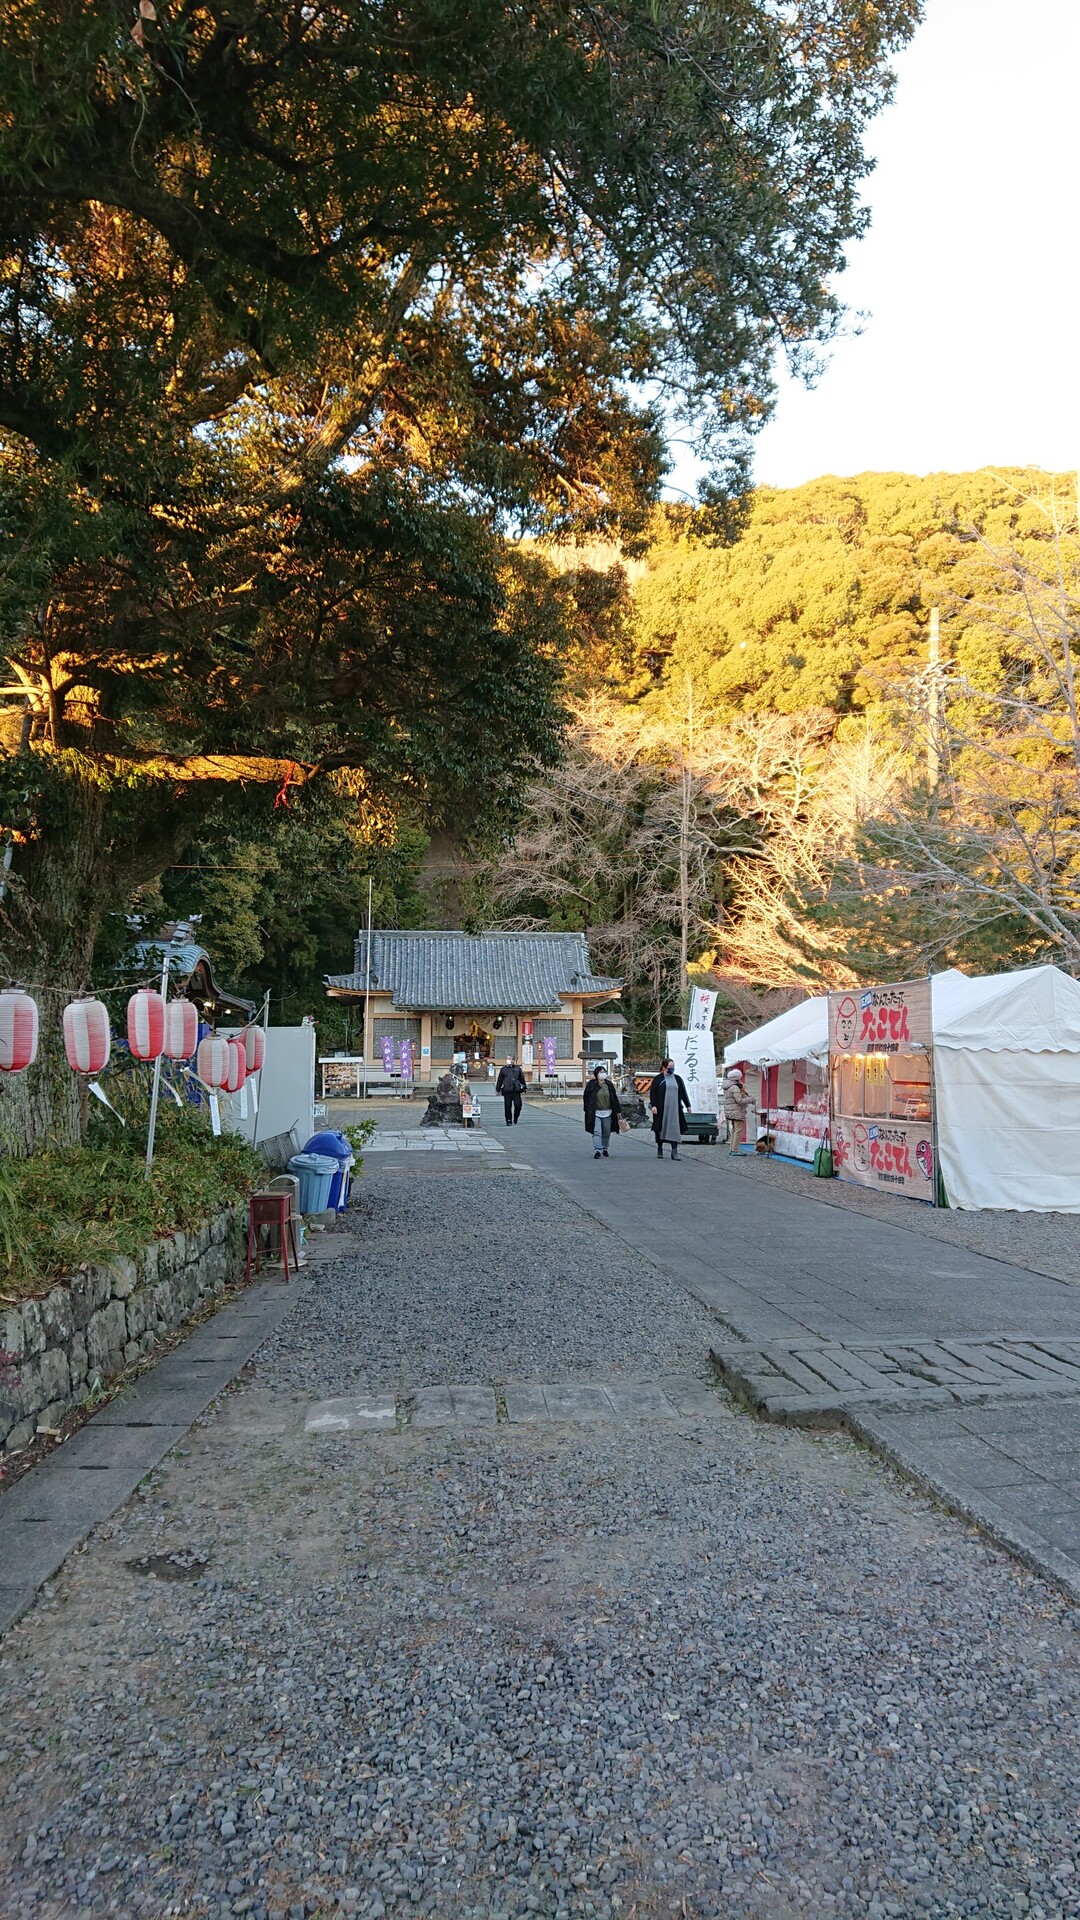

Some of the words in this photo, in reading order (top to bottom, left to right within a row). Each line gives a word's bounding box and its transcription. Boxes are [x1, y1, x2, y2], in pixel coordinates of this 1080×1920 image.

[700, 993, 710, 1004] 祈
[859, 1003, 910, 1042] たこでん
[684, 1034, 700, 1082] だるま
[870, 1138, 913, 1178] たこでん
